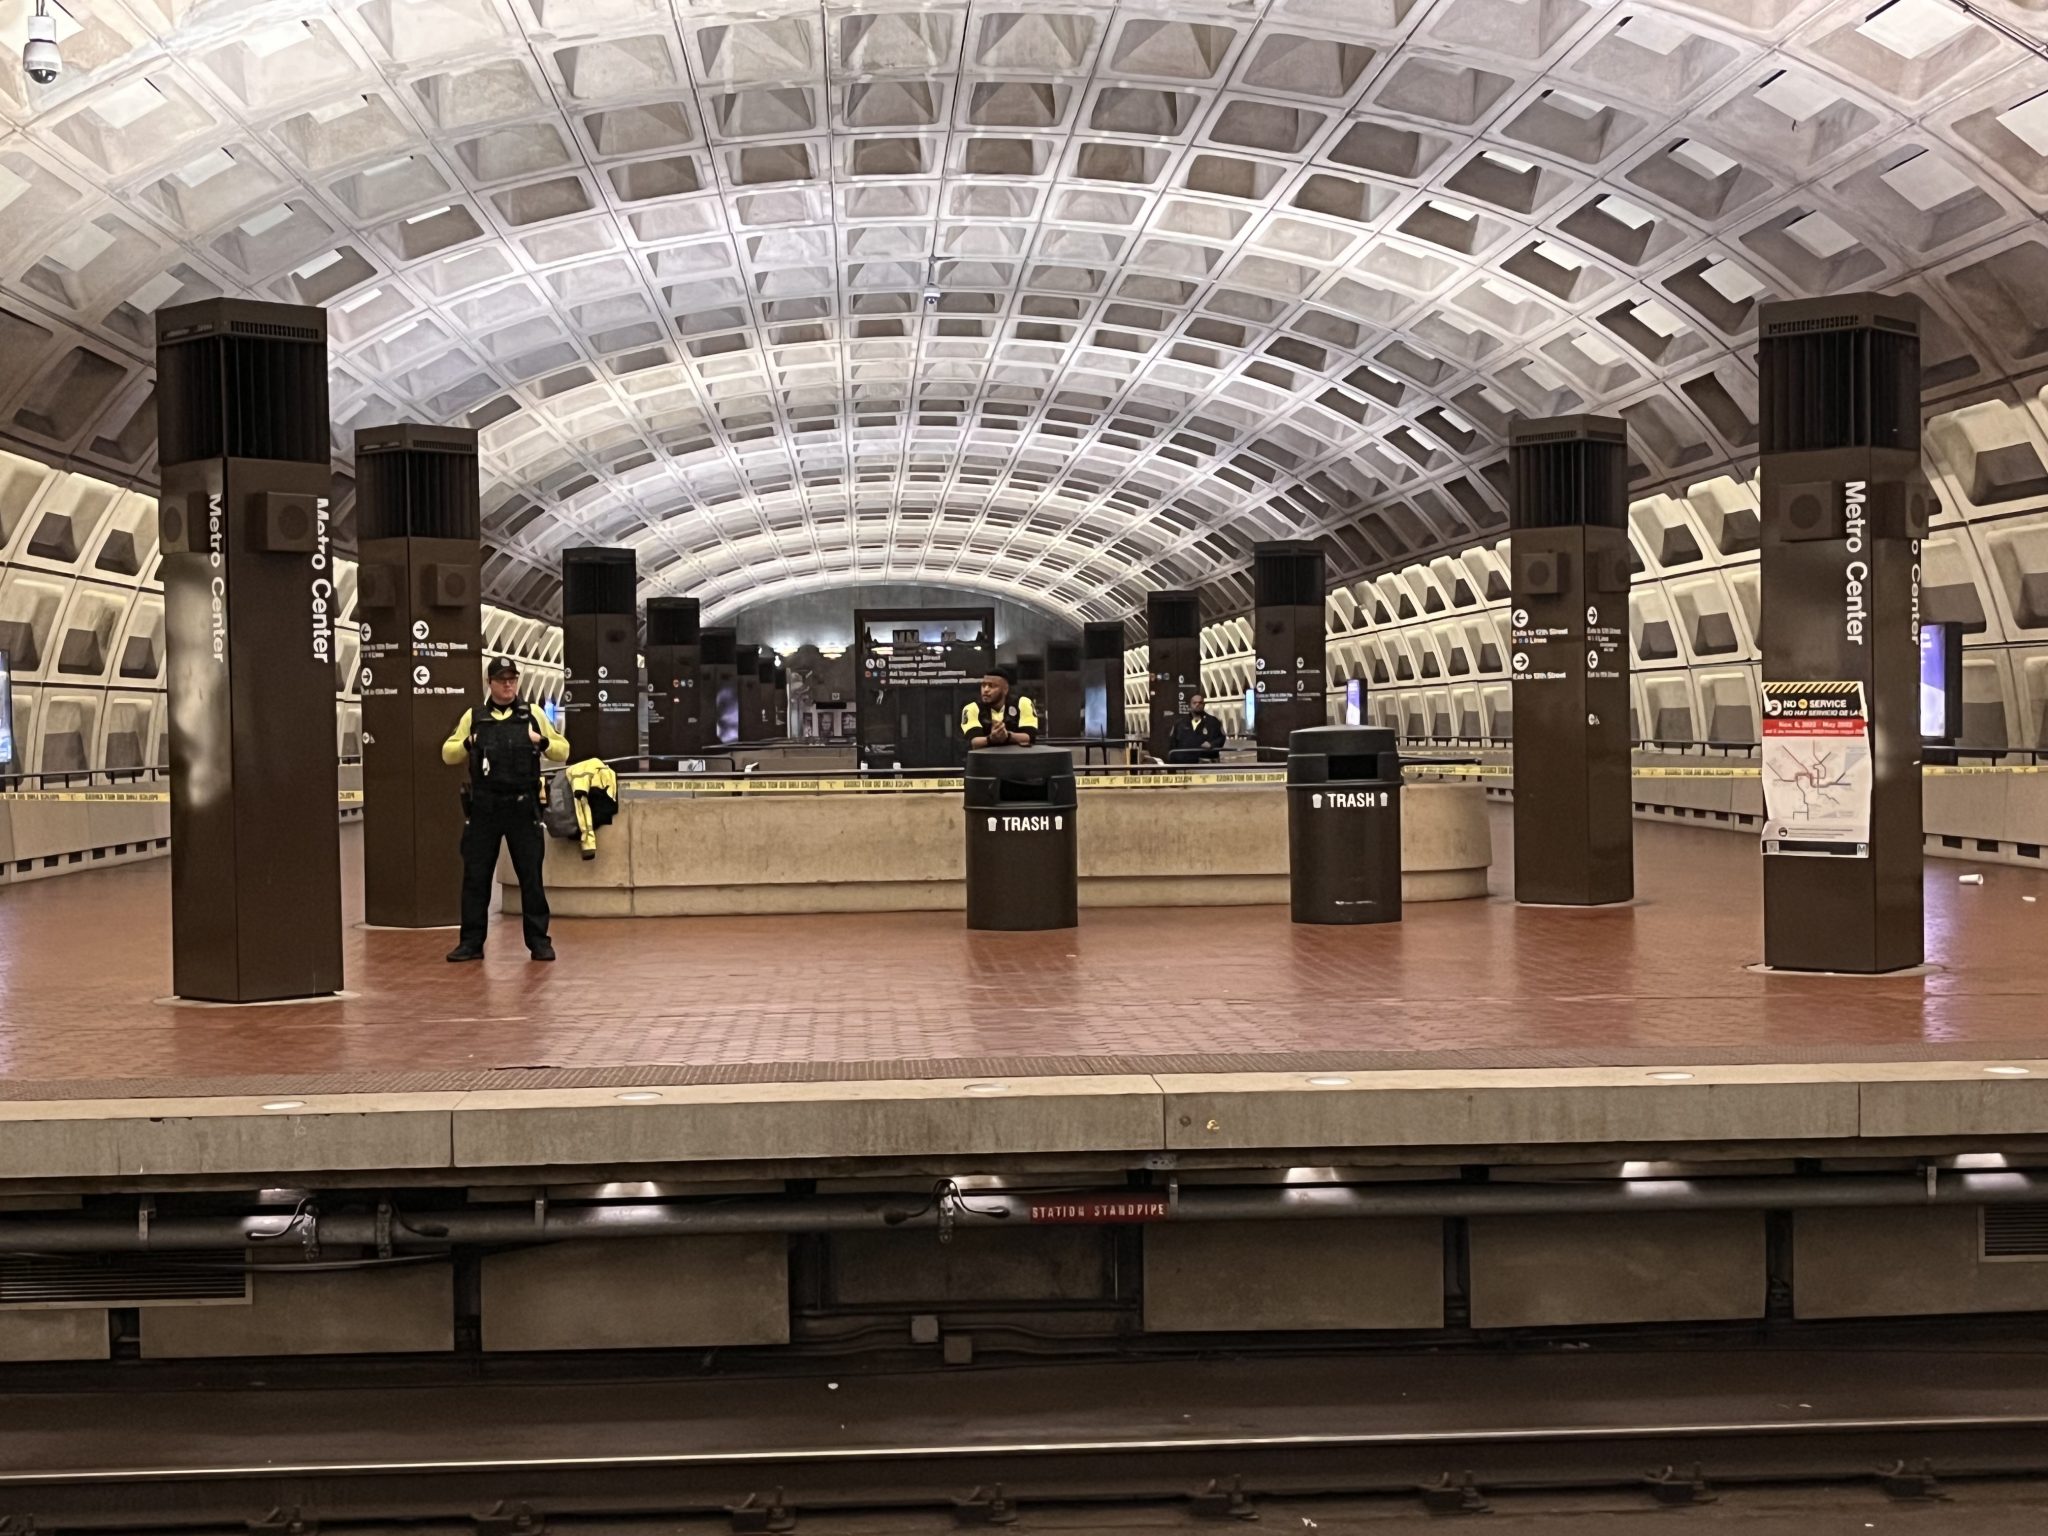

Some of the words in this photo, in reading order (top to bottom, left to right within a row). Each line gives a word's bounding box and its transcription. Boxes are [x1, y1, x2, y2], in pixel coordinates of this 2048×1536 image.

[209, 493, 223, 568] Metro
[1845, 481, 1866, 553] Metro
[211, 577, 225, 663] Center
[311, 578, 332, 664] Center
[1846, 561, 1868, 645] Center
[1911, 564, 1921, 645] Center
[1783, 700, 1797, 709] NO
[1809, 700, 1847, 708] SERVICE
[1002, 816, 1049, 831] TRASH
[1327, 792, 1375, 808] TRASH
[1032, 1206, 1085, 1218] STATION
[1094, 1204, 1164, 1217] STANDPIPE
